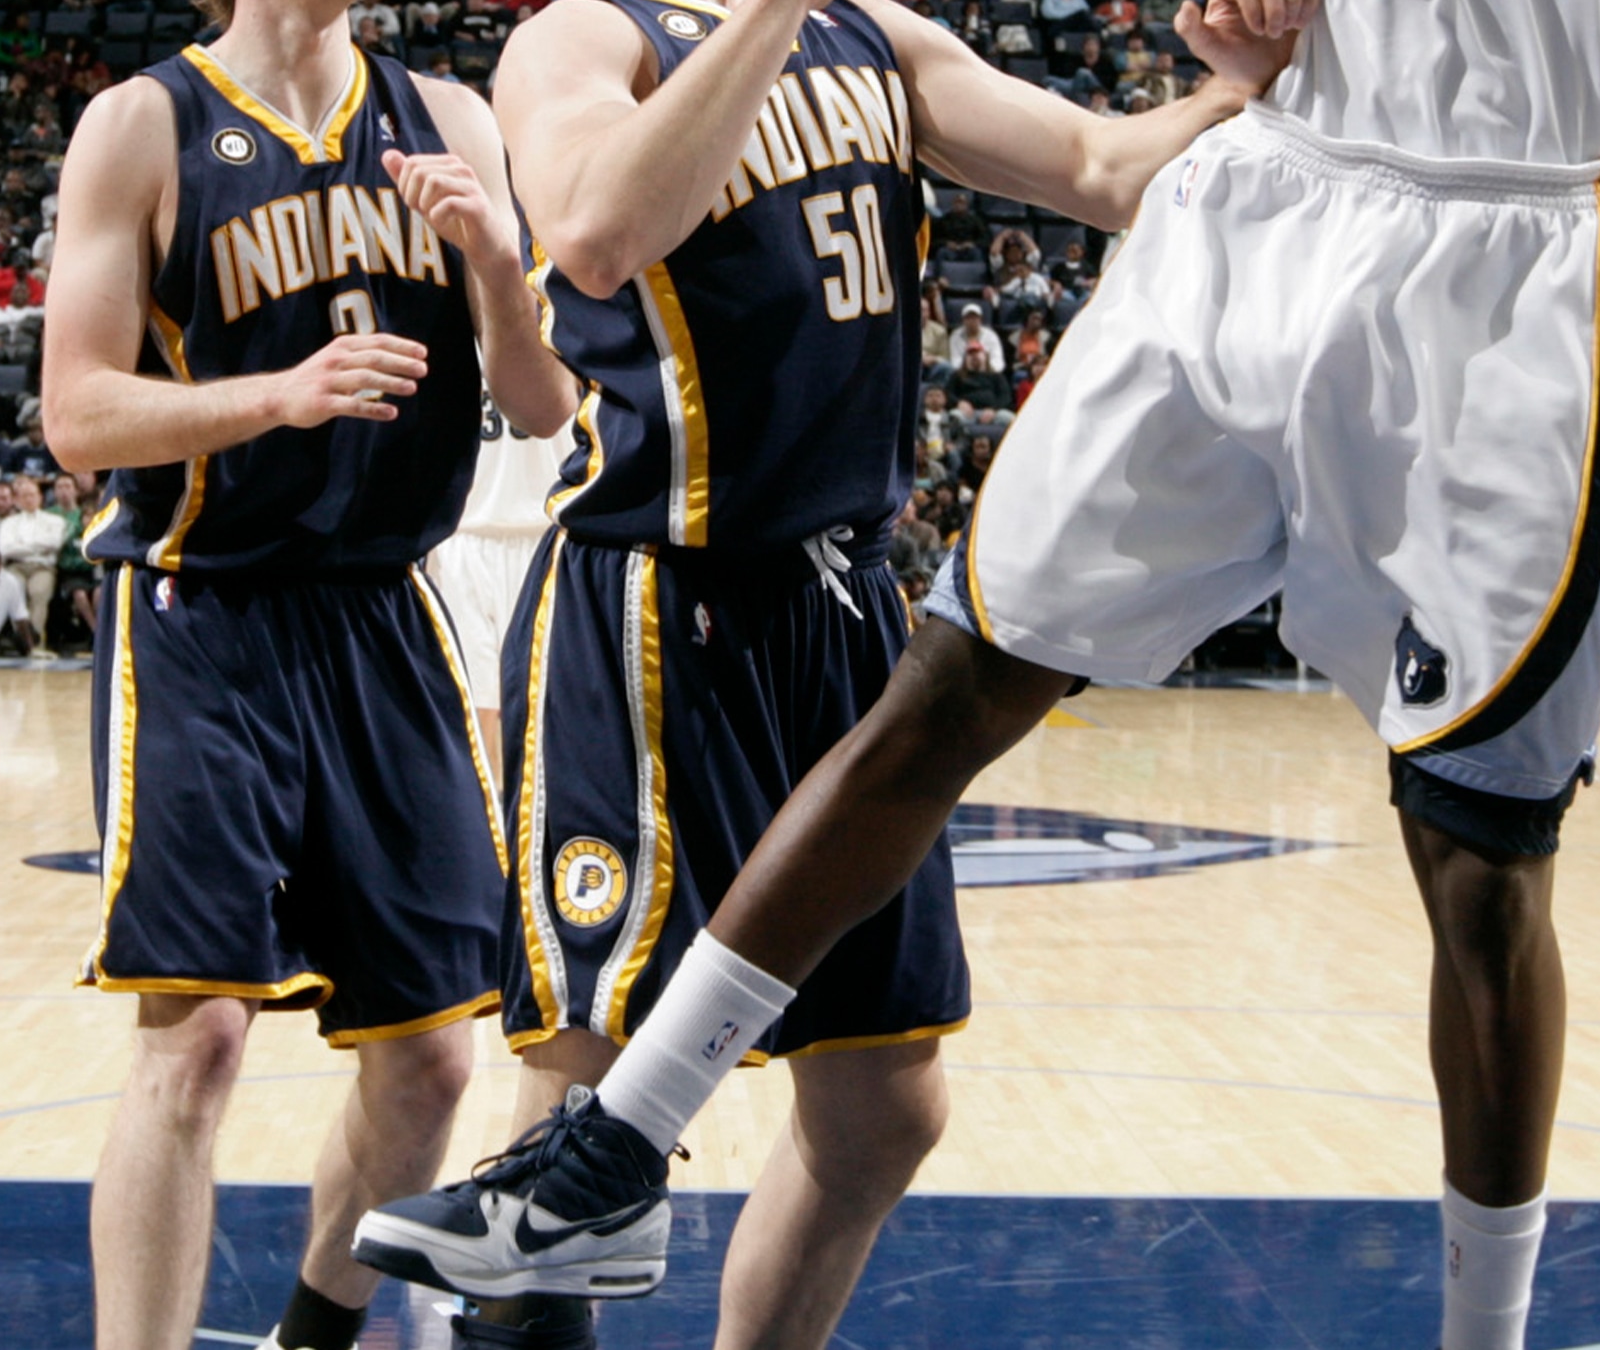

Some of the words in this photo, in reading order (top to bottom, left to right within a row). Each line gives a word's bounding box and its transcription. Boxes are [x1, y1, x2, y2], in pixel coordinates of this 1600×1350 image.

[711, 65, 914, 224] NDIAN
[209, 183, 450, 324] INDIANA
[800, 184, 895, 322] 50
[480, 389, 532, 442] 3
